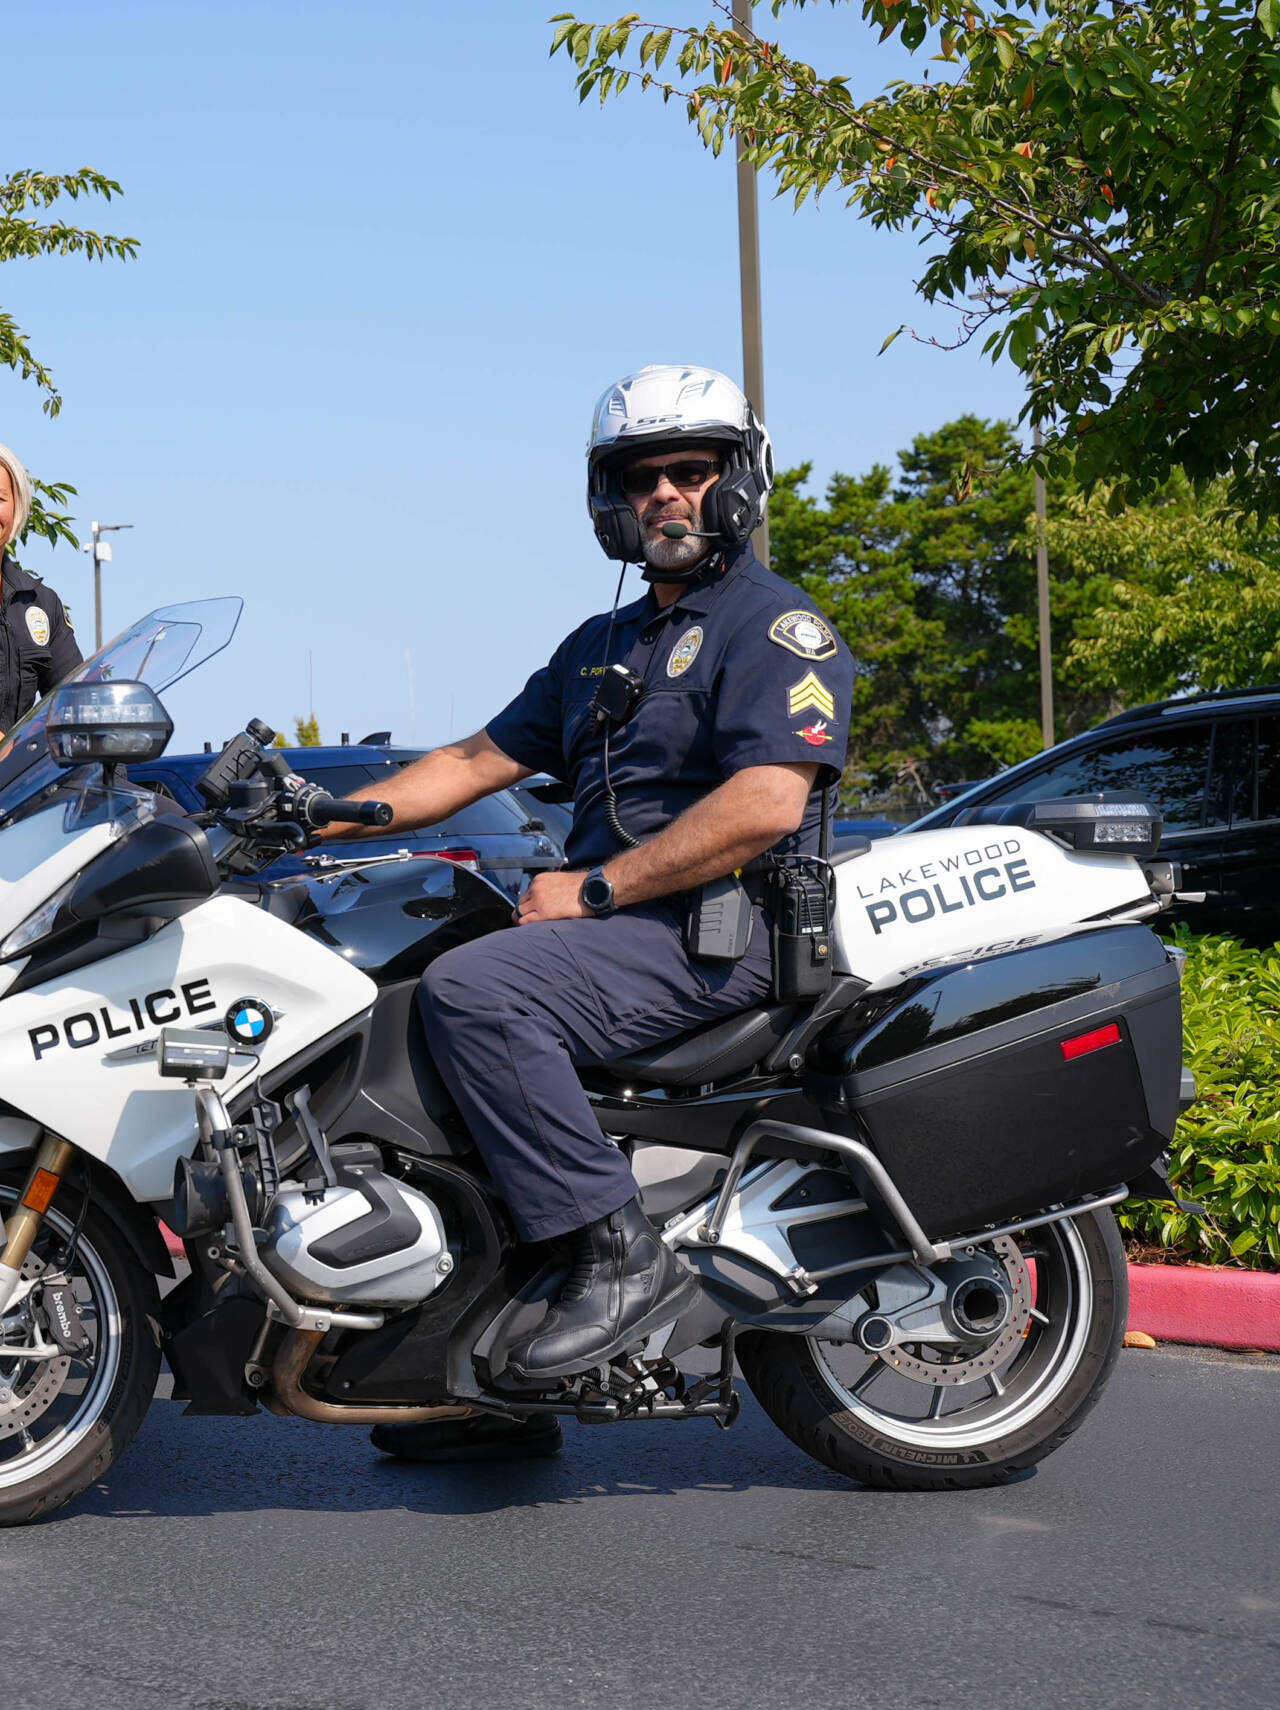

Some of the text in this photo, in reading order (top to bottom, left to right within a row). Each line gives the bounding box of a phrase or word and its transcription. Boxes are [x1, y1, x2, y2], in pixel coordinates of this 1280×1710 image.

[777, 614, 812, 632] LAKEWOOD
[856, 839, 1021, 899] LAKEWOOD
[865, 858, 1036, 934] POLICE
[27, 978, 216, 1060] POLICE
[53, 1291, 72, 1339] brembo
[879, 1442, 959, 1465] MICHELIN
